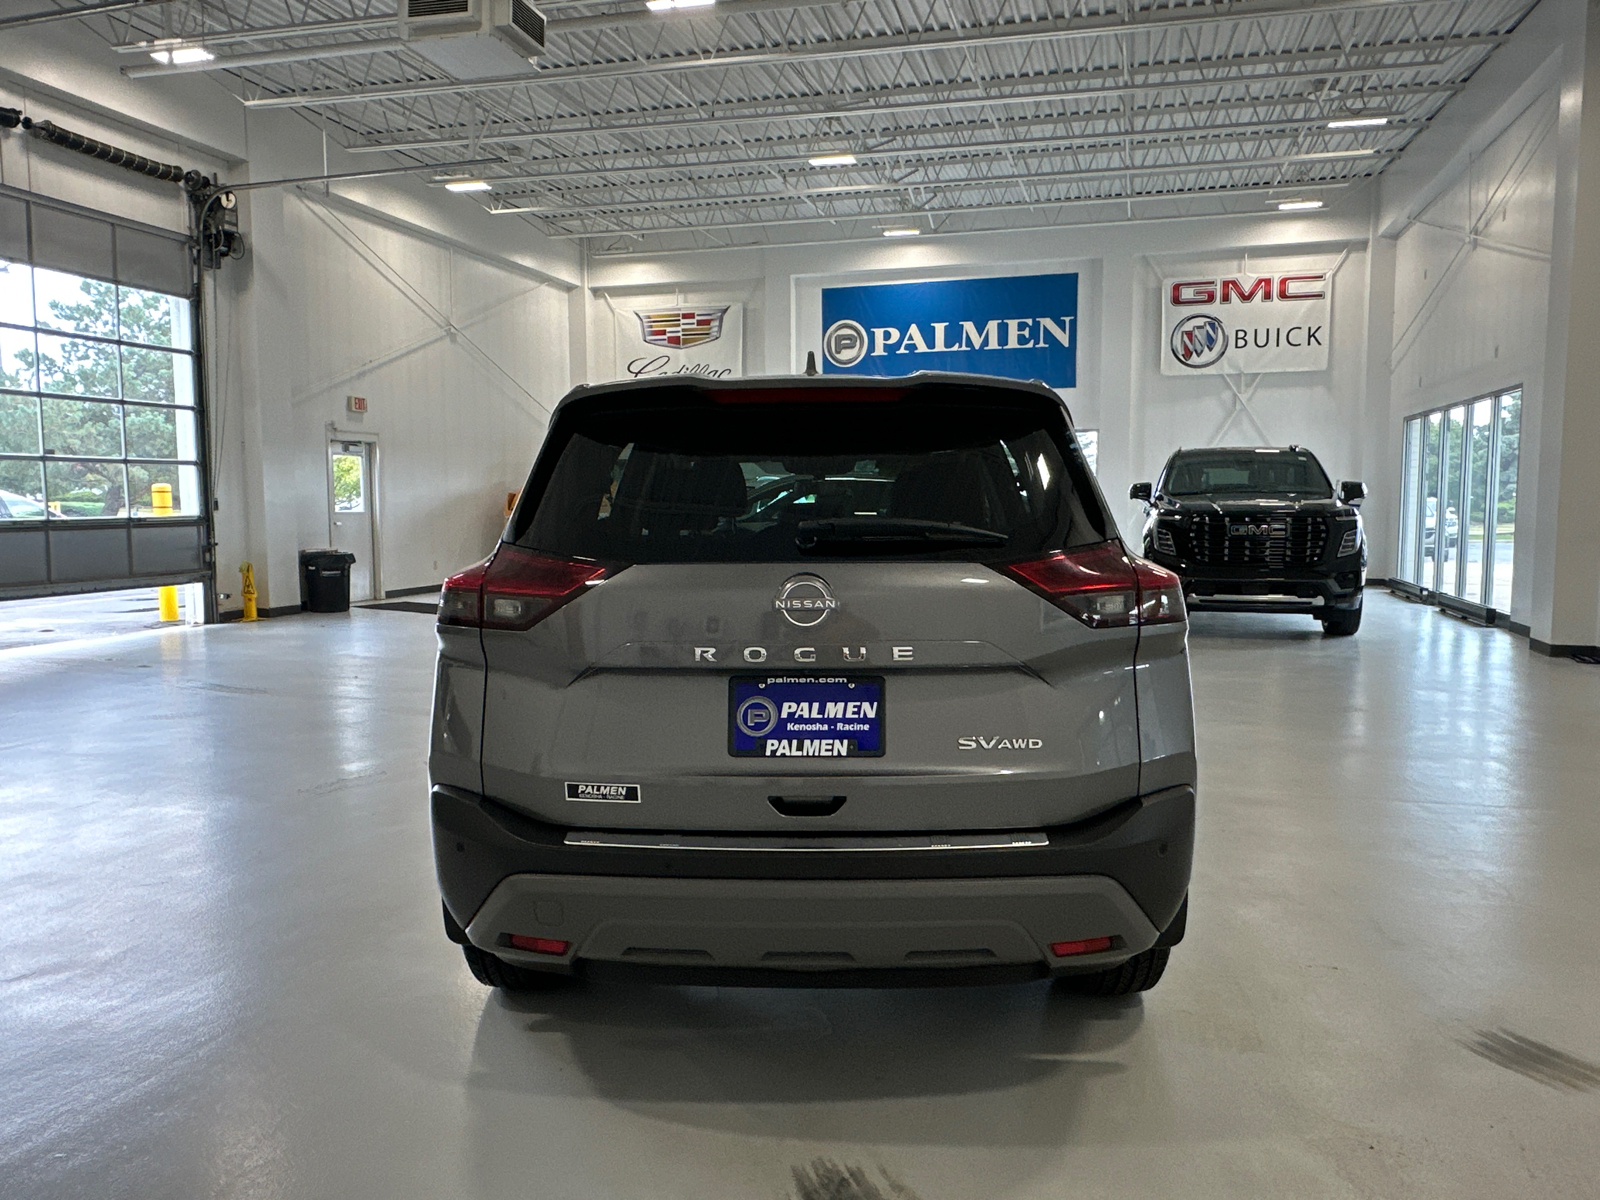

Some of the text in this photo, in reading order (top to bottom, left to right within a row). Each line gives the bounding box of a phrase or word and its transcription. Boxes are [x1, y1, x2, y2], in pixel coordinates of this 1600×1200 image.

[1170, 274, 1326, 307] GMC
[870, 317, 1074, 356] PALMEN
[1234, 325, 1322, 349] BUICK
[1230, 524, 1286, 536] GMC
[775, 600, 835, 608] NISSAN
[694, 646, 914, 661] ROGUE
[767, 676, 847, 684] palmen.com
[780, 702, 878, 718] PALMEN
[787, 722, 828, 731] Kenosha
[836, 722, 870, 731] Racine
[765, 739, 849, 756] PALMEN
[578, 785, 626, 795] PALMEN
